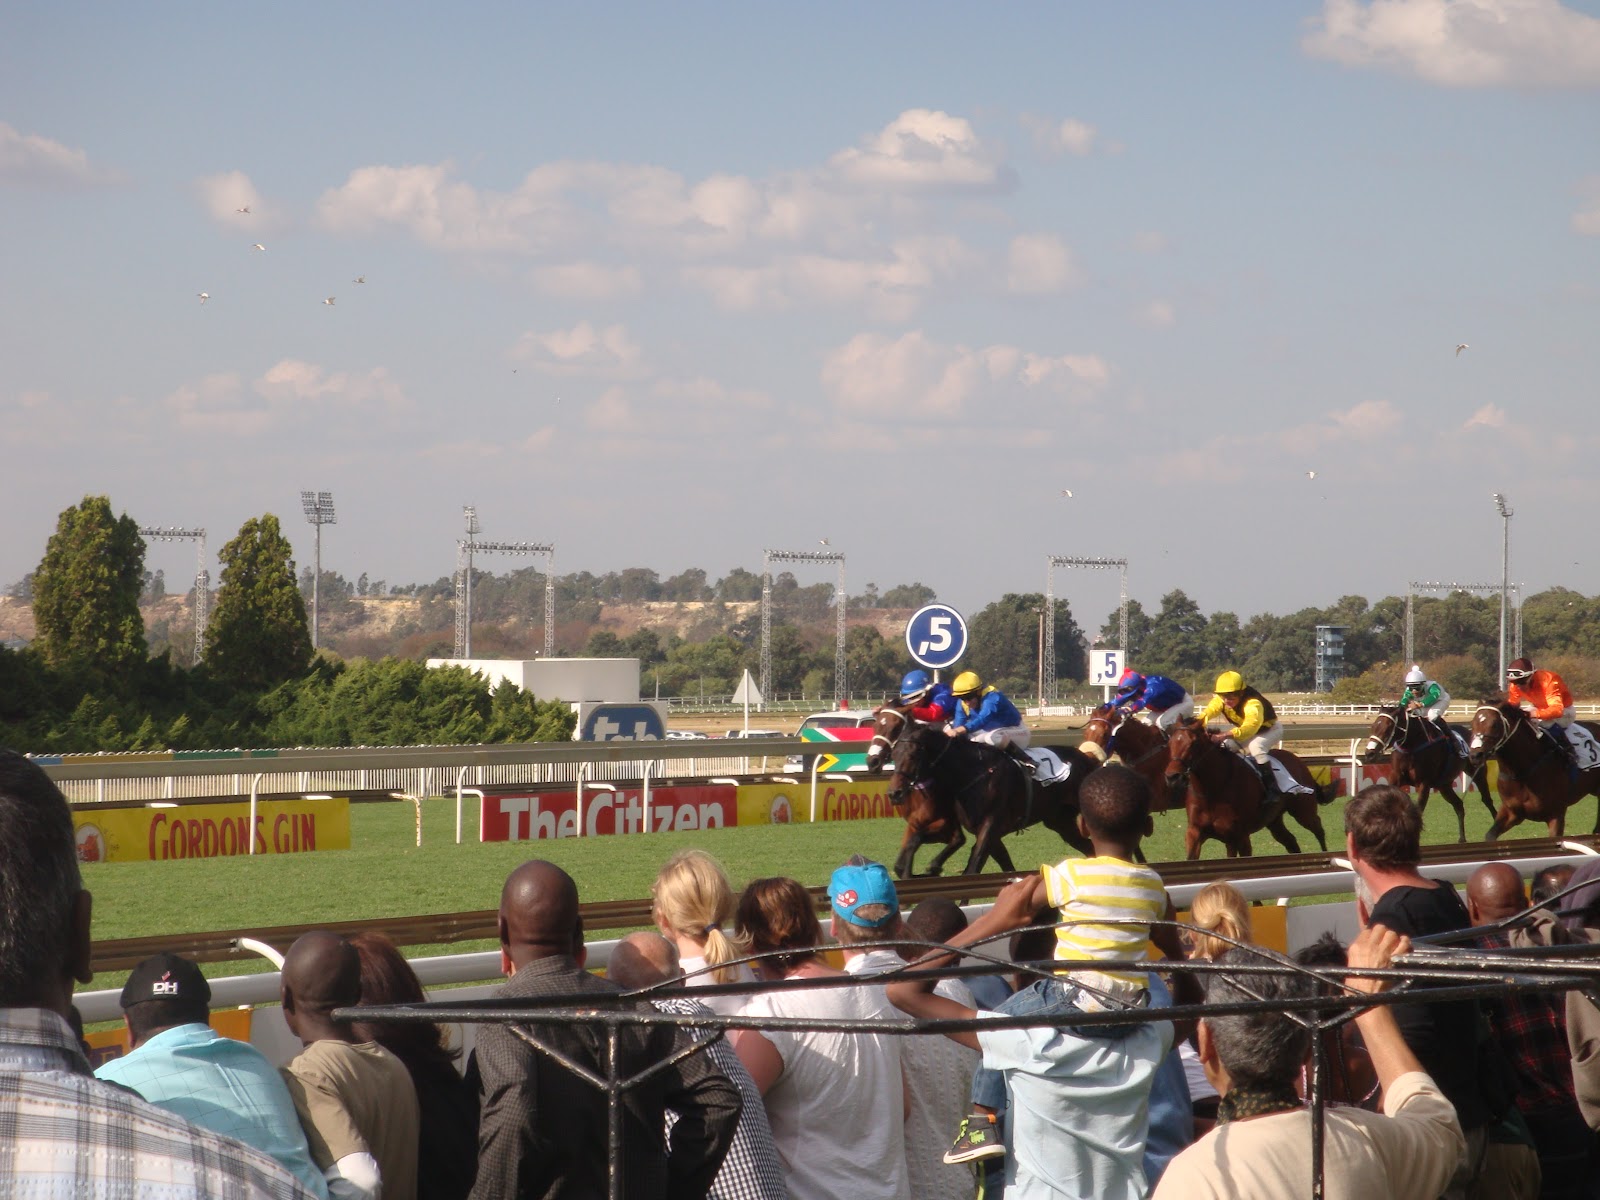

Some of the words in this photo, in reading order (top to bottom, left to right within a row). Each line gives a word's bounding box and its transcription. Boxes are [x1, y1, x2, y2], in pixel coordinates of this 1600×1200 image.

[593, 716, 657, 742] tb
[1584, 740, 1598, 762] 3
[1040, 757, 1056, 777] 7
[500, 797, 578, 841] The
[586, 792, 724, 837] Citizen
[273, 813, 316, 854] GIN
